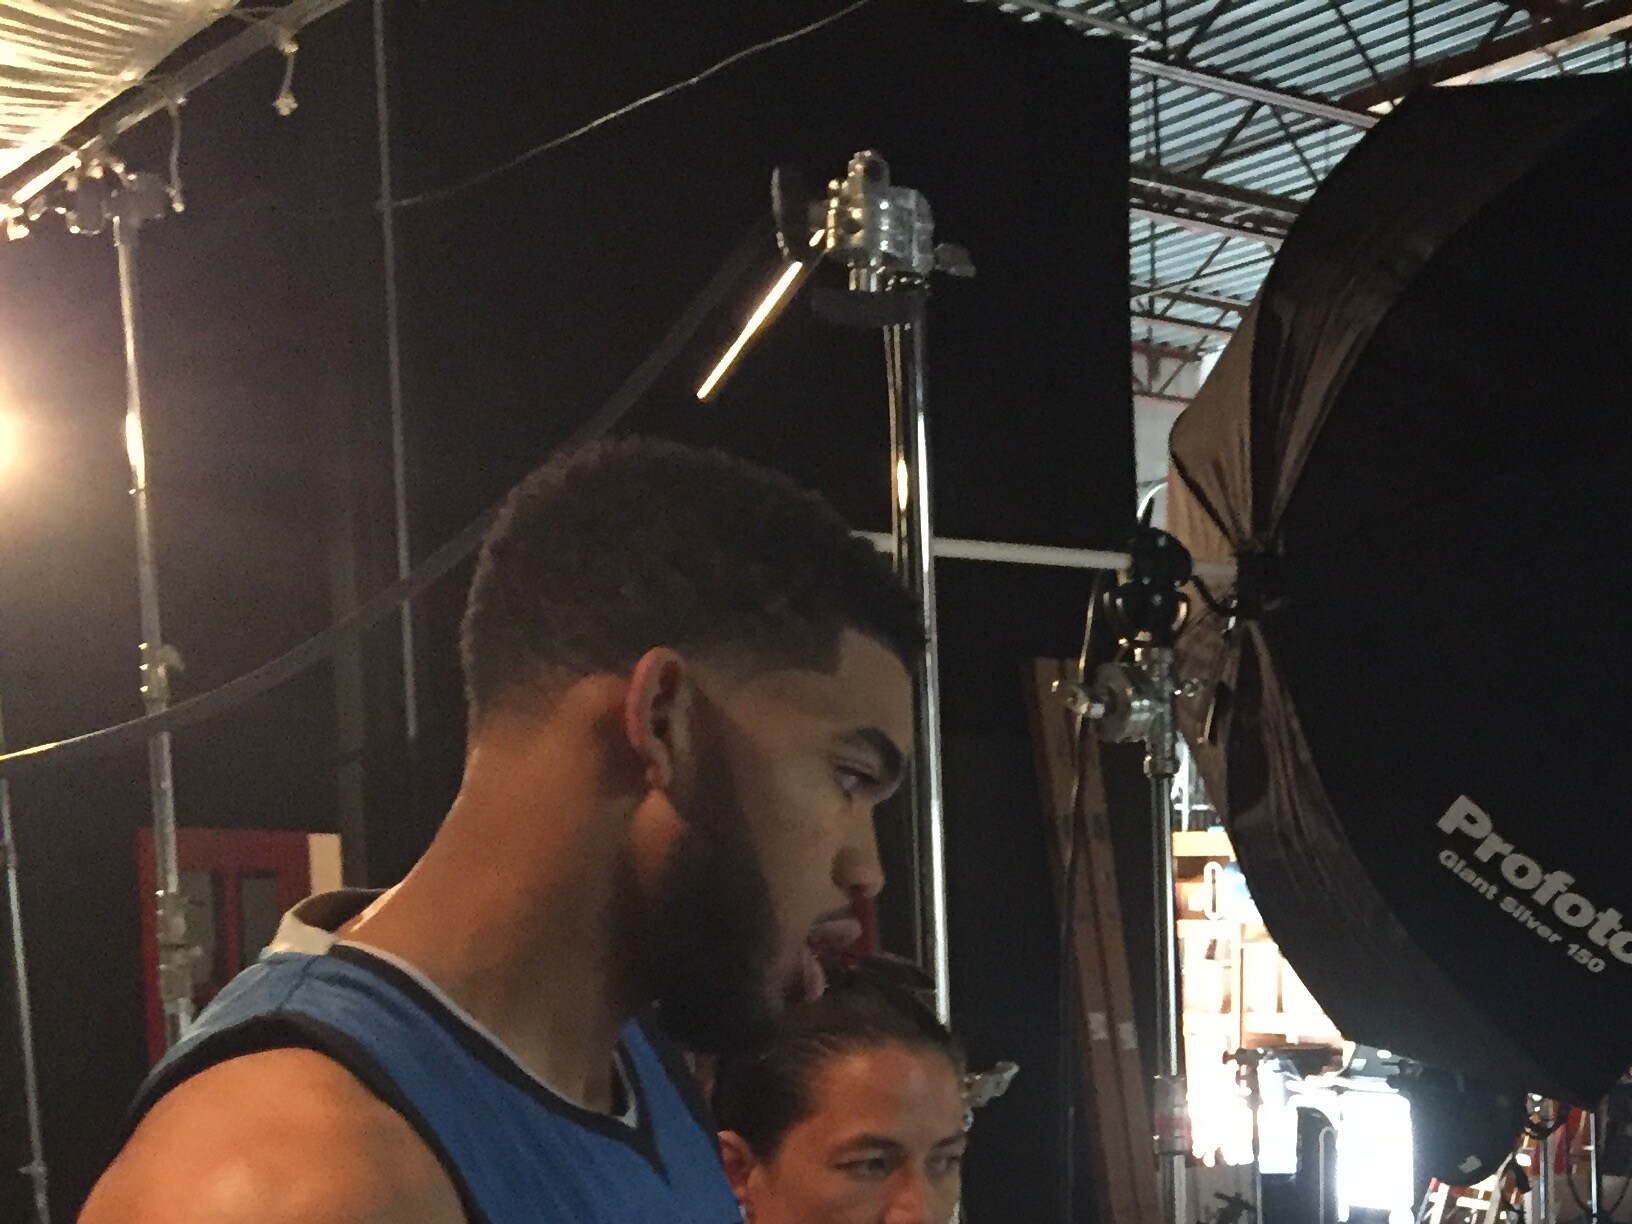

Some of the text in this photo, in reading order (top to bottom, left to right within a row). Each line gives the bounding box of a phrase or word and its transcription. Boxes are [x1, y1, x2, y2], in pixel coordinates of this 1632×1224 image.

[1438, 849, 1607, 974] Giant Silver 150
